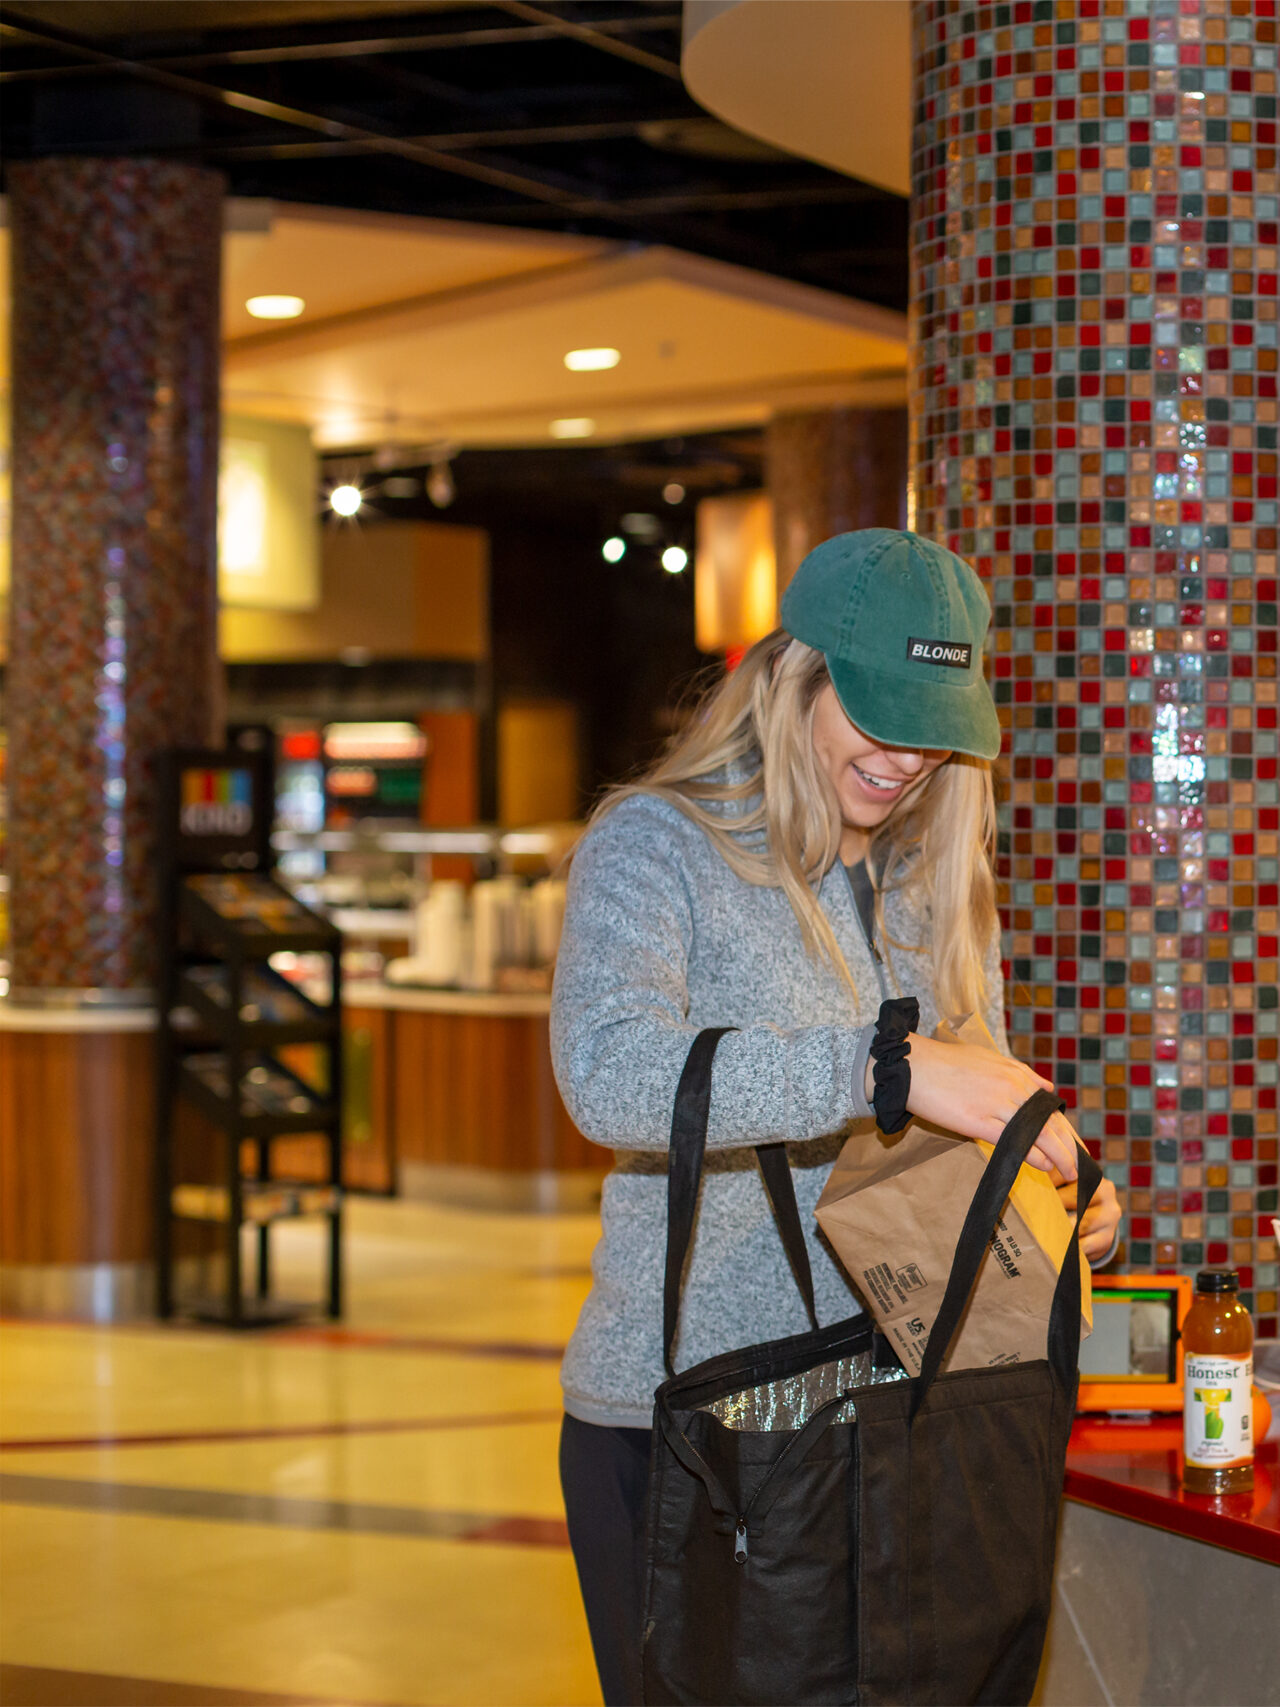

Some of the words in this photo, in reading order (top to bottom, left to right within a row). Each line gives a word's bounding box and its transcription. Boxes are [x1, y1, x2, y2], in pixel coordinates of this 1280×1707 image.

[912, 644, 968, 663] BLONDE
[990, 1234, 1021, 1278] NOGRAM
[1187, 1365, 1240, 1379] Honest
